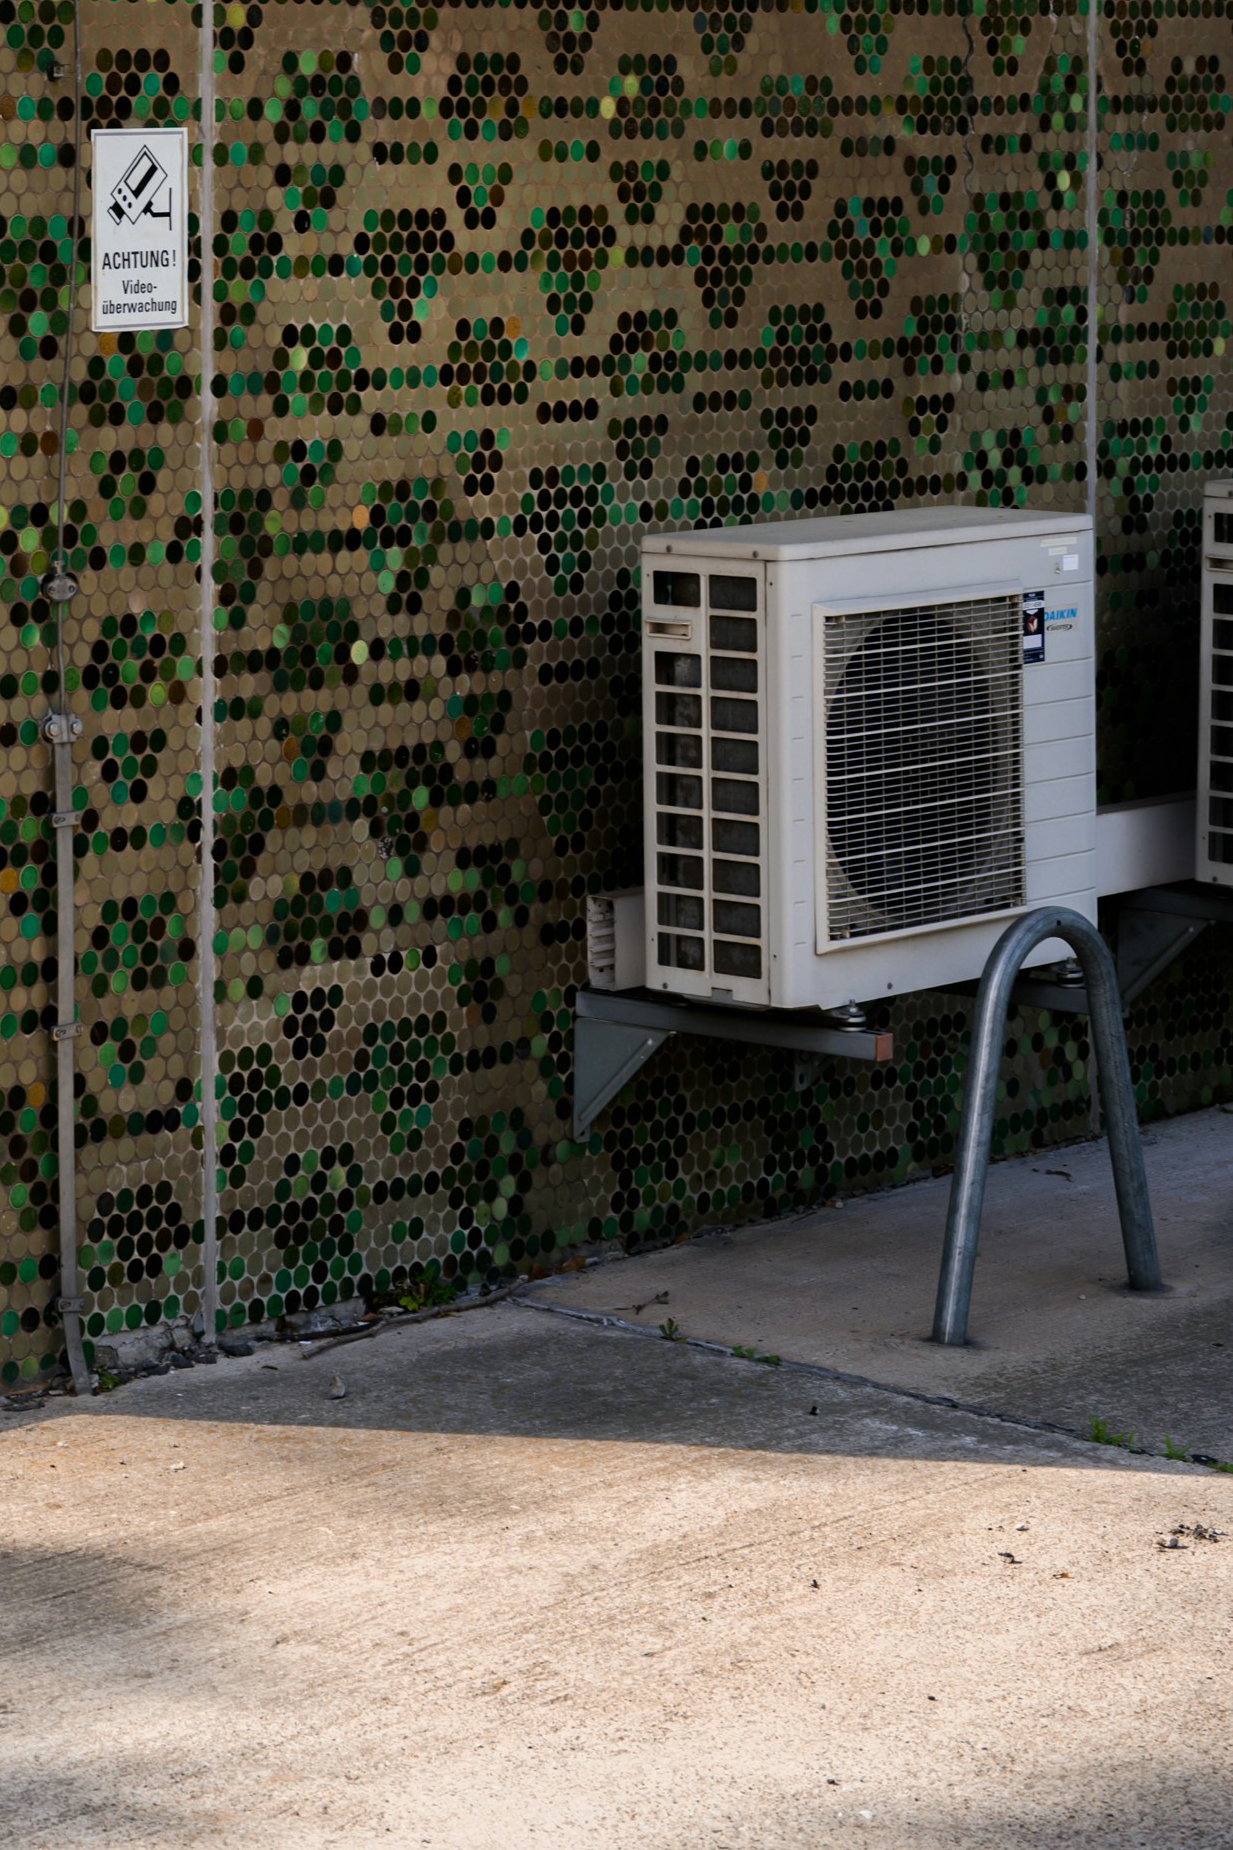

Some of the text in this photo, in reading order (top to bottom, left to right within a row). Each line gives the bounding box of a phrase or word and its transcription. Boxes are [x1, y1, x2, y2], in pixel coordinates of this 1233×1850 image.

[122, 280, 157, 294] Video-
[102, 298, 177, 314] überwachung
[1044, 608, 1077, 621] DAIKIN
